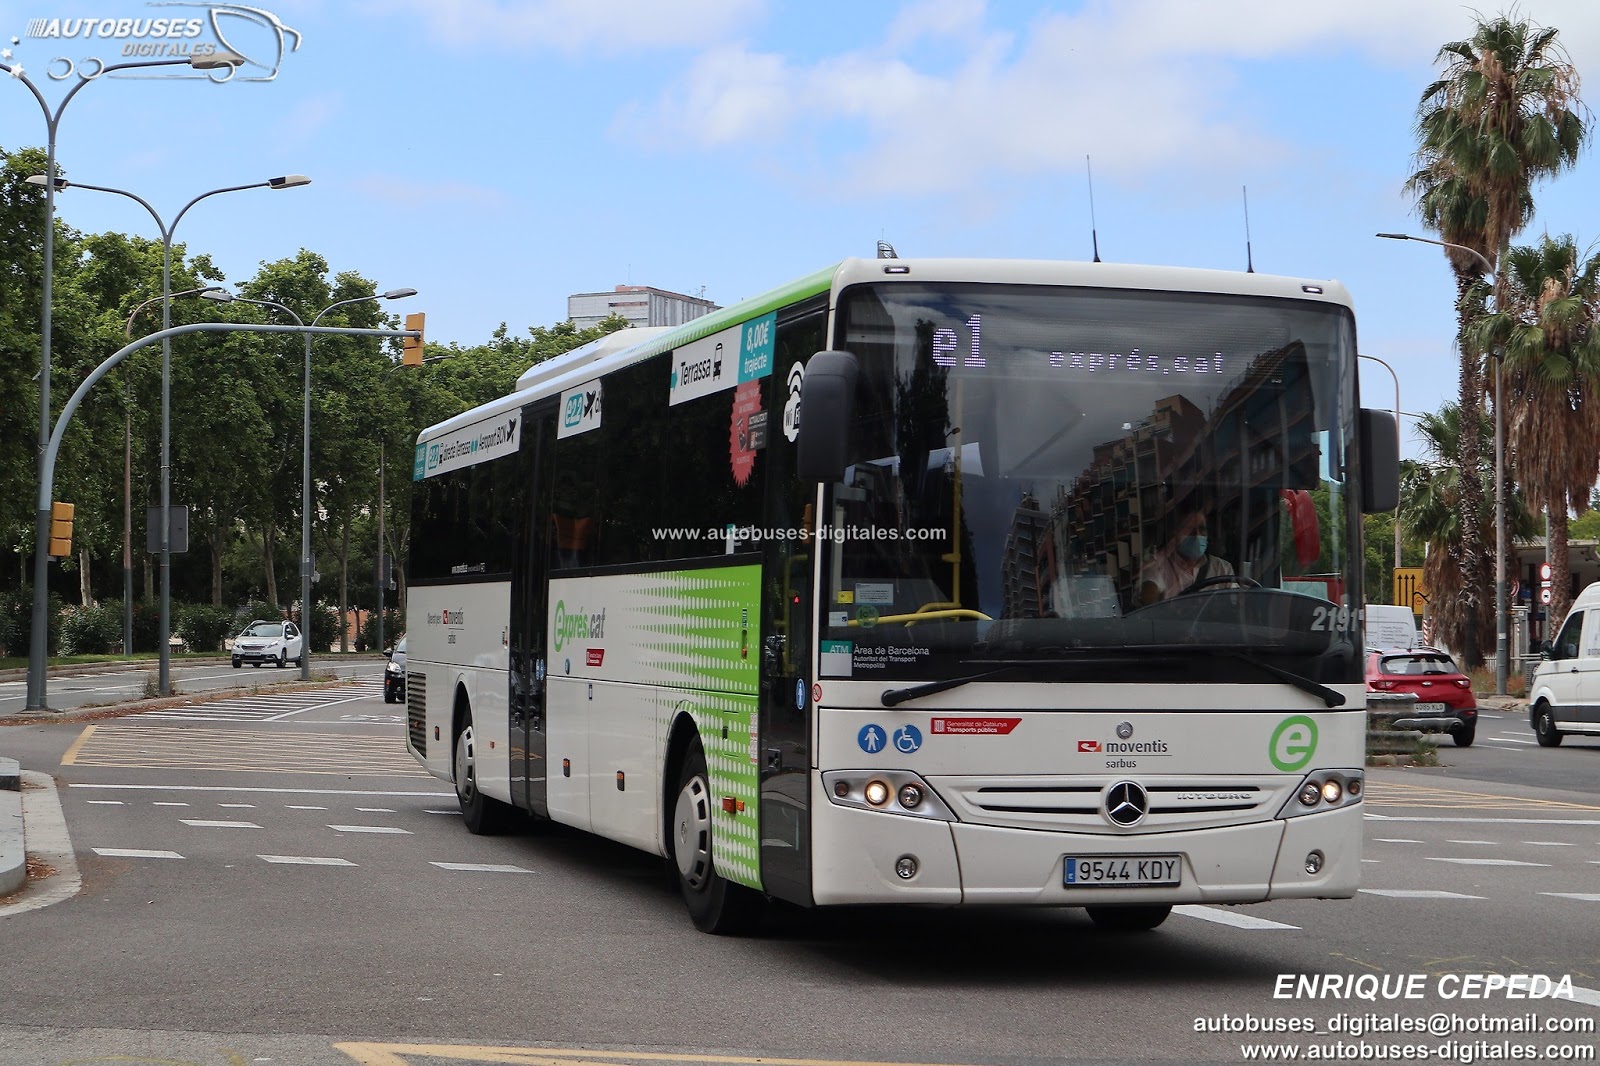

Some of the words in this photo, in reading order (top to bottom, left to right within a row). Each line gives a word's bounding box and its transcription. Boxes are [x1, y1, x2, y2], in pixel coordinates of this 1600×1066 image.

[932, 313, 986, 368] e1
[744, 353, 768, 377] trajecte
[1048, 348, 1224, 375] exprés.cat
[680, 358, 711, 387] Terrassa
[479, 429, 497, 454] Aeroport
[1310, 606, 1358, 632] 2191
[830, 645, 849, 654] ATM
[853, 643, 873, 655] Àrea
[874, 646, 886, 655] de
[887, 646, 930, 655] Barcelona
[889, 655, 916, 663] Transport
[982, 720, 1008, 728] Catalunya
[1106, 740, 1168, 753] moventis
[1105, 758, 1137, 768] sarbus
[1079, 861, 1131, 881] 9544
[1138, 860, 1176, 880] KDY
